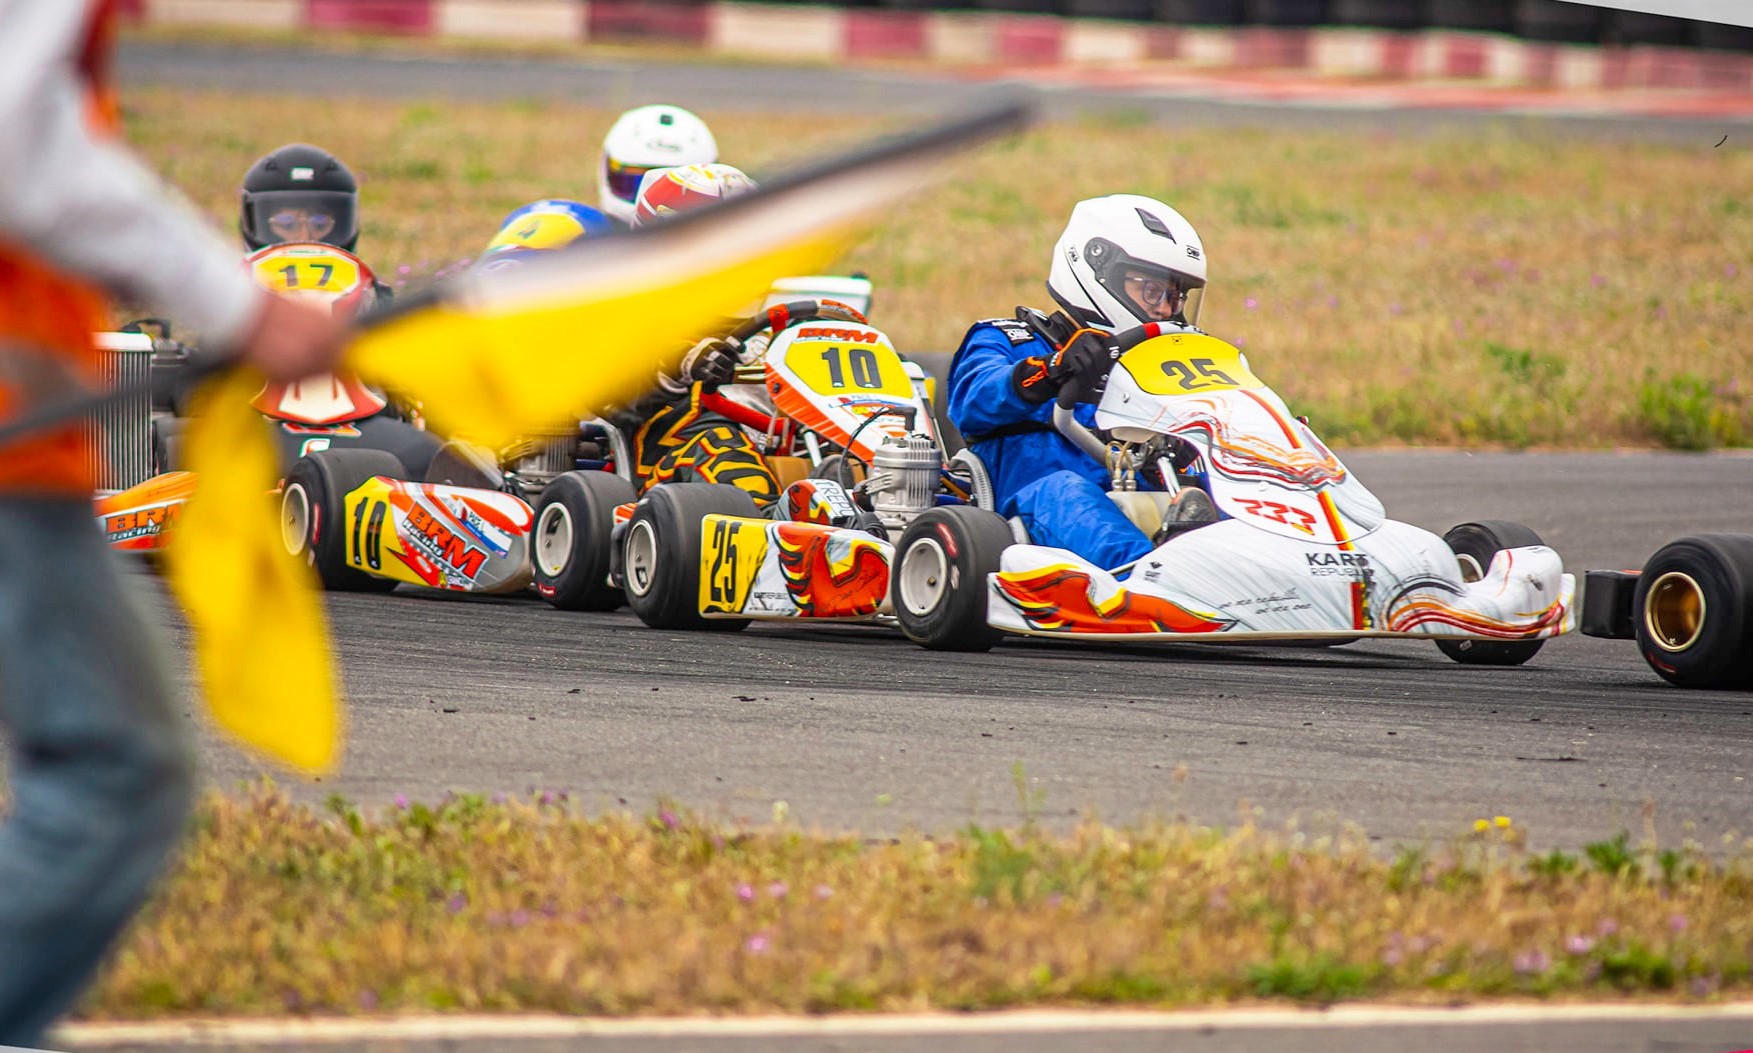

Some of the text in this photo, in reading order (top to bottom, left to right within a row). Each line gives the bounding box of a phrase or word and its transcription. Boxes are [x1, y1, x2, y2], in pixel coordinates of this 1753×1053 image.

[279, 264, 334, 287] 17
[797, 327, 879, 344] BRM
[821, 346, 883, 389] 10
[1160, 357, 1240, 391] 25
[354, 496, 387, 571] 10
[406, 501, 488, 580] BRM
[711, 519, 743, 604] 25
[1305, 552, 1368, 567] KART
